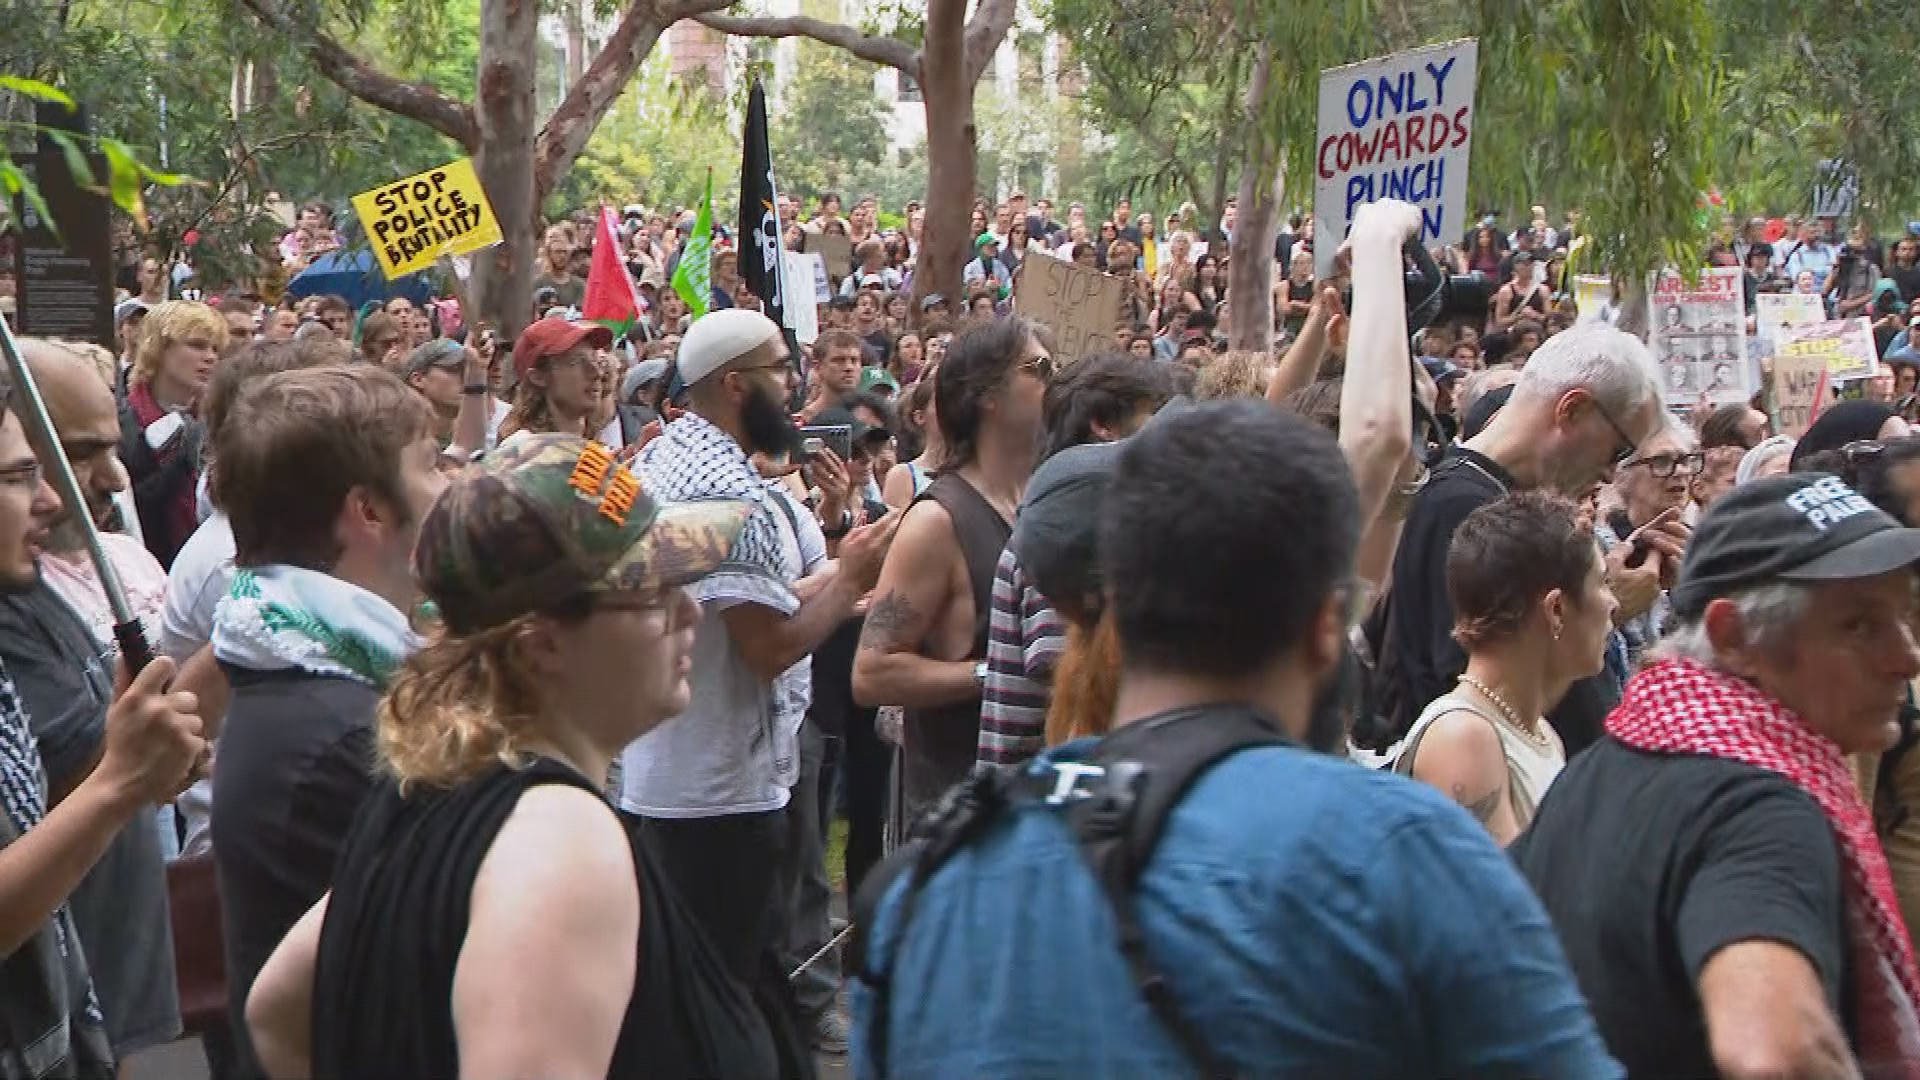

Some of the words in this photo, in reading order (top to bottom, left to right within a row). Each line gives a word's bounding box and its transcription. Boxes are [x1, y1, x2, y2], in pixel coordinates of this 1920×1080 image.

[1347, 57, 1455, 128] ONLY
[1319, 106, 1469, 179] COWARDS
[375, 171, 446, 216] STOP
[1345, 156, 1445, 220] PUNCH
[373, 189, 466, 244] POLICE
[384, 204, 480, 267] BRUTALITY
[1047, 261, 1104, 307] STOP
[1656, 273, 1737, 293] AREST
[1786, 476, 1855, 513] FREE
